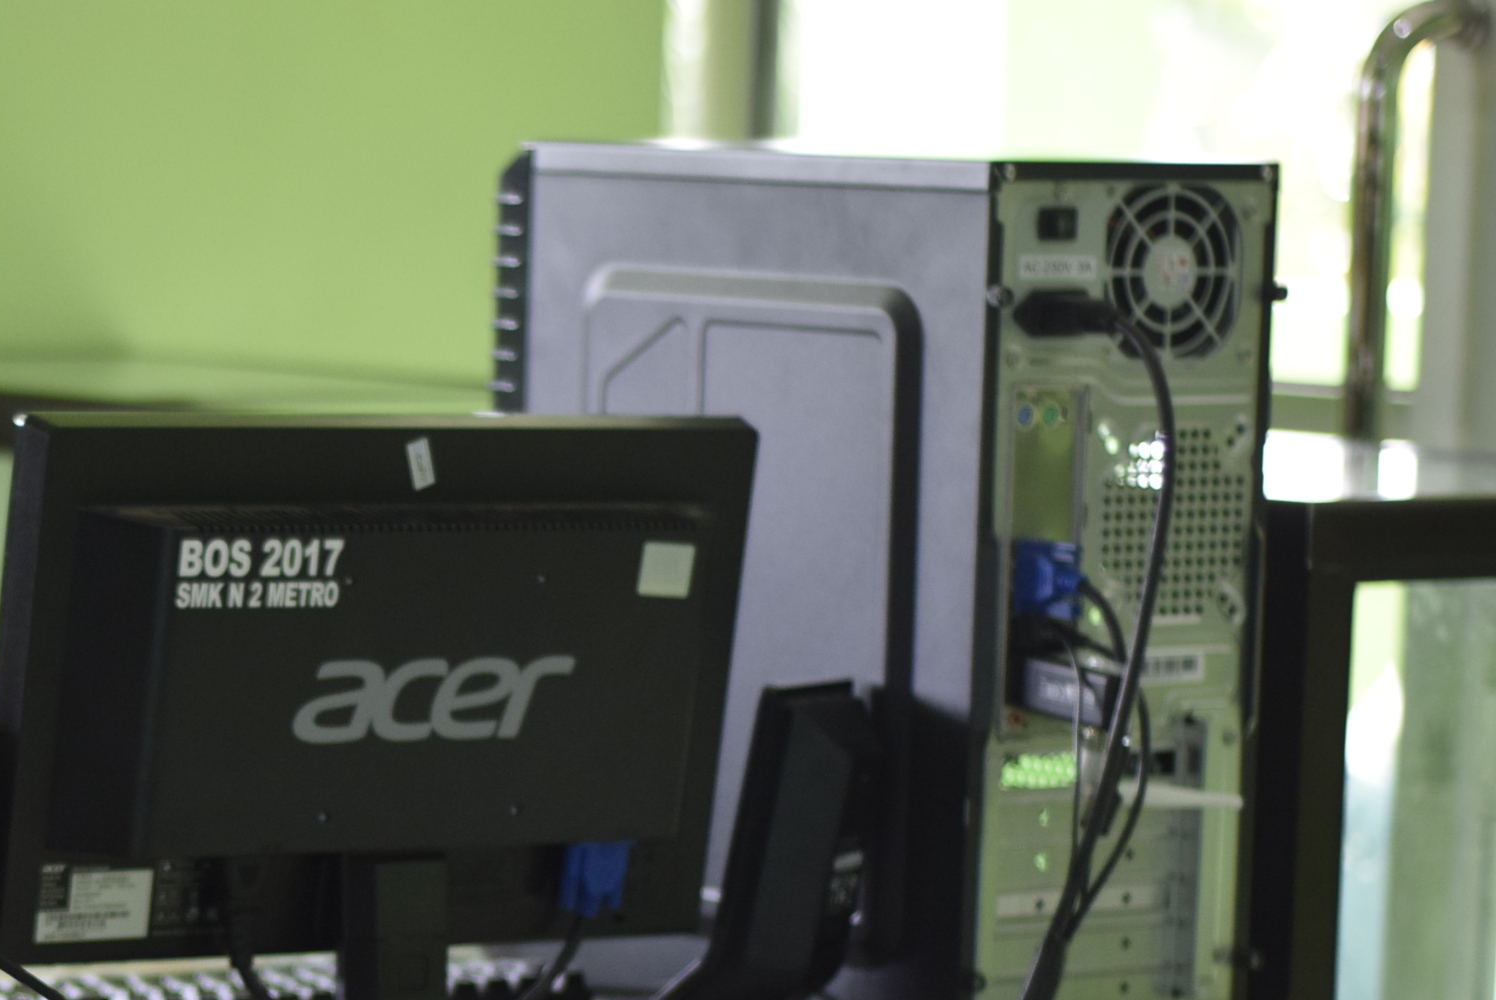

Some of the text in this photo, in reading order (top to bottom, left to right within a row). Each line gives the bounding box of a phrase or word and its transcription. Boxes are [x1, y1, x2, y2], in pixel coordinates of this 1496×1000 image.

[178, 538, 345, 578] BOS 2017
[175, 582, 340, 608] SMK N 2 METRO
[292, 655, 575, 743] acer
